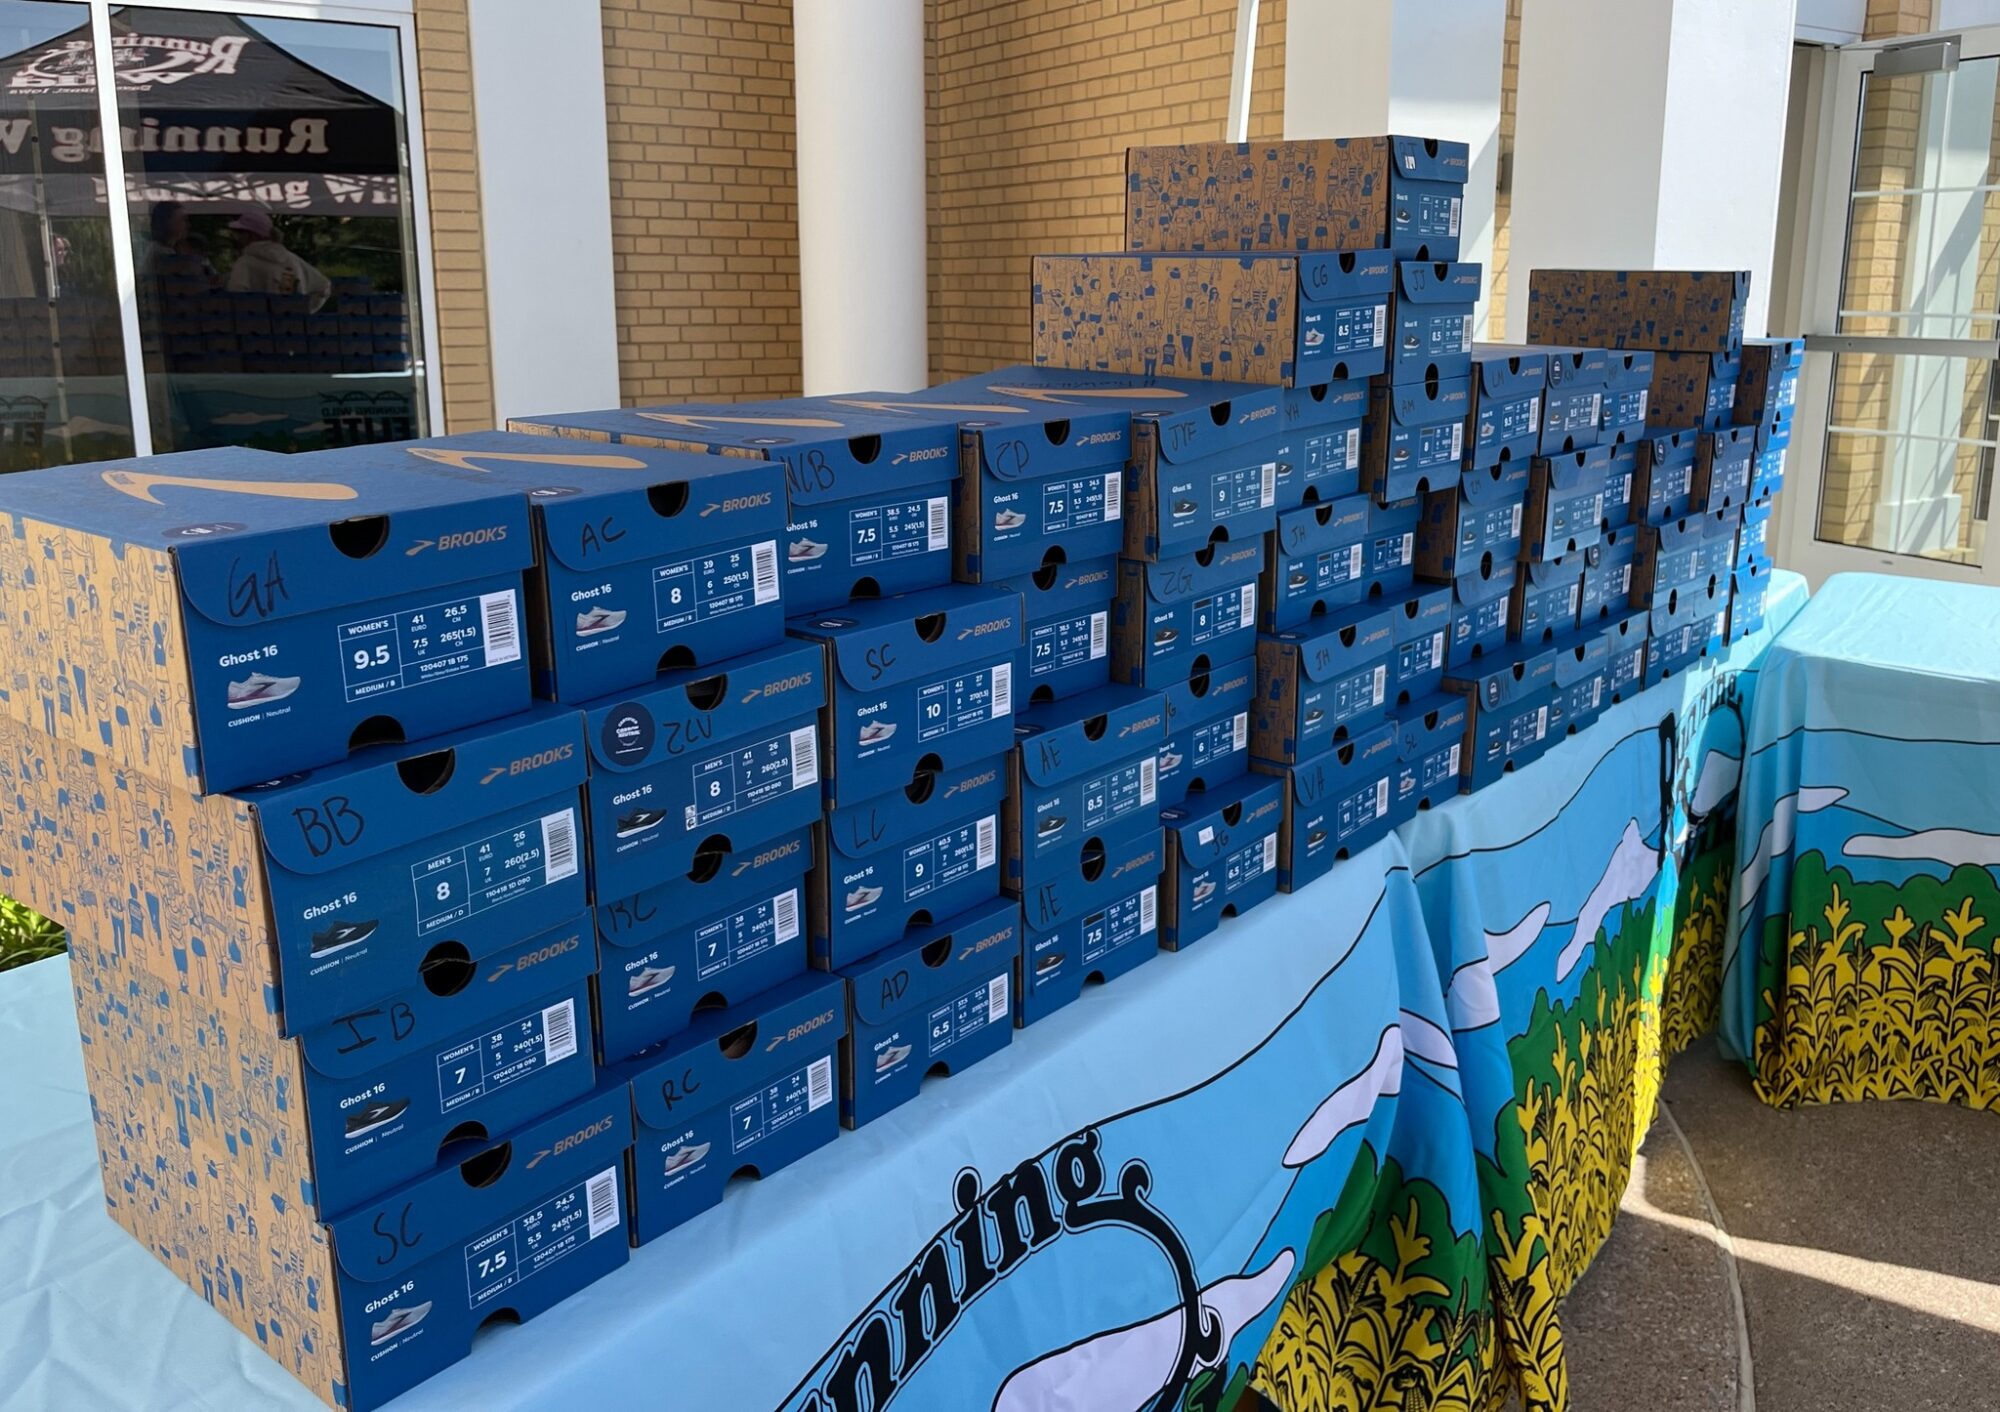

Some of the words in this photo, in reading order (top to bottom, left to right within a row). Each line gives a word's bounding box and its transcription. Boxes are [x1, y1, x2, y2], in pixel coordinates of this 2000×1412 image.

[1339, 325, 1349, 336] 8.5
[1090, 431, 1122, 443] BROOKS
[909, 447, 948, 462] BROOKS
[722, 492, 772, 512] BROOKS
[1219, 490, 1225, 501] 9
[1049, 500, 1063, 514] 7.5
[786, 522, 808, 532] Ghost
[810, 520, 817, 528] 16
[858, 528, 876, 543] 7.5
[438, 526, 507, 551] BROOKS
[581, 517, 626, 557] AC
[660, 564, 688, 577] WOMEN'S
[703, 560, 714, 569] 39
[730, 554, 740, 562] 25
[571, 587, 599, 602] Ghost
[601, 584, 612, 594] 16
[707, 580, 713, 589] 6
[671, 588, 681, 604] 8
[412, 614, 424, 625] 41
[444, 605, 467, 618] 26.5
[1200, 615, 1206, 626] 8
[348, 619, 390, 635] WOMEN'S
[974, 617, 1012, 636] BROOKS
[412, 638, 428, 649] 7.5
[440, 626, 476, 643] 265(1.5)
[219, 649, 260, 668] Ghost
[262, 645, 279, 659] 16
[353, 645, 391, 670] 9.5
[1036, 643, 1050, 657] 7.5
[866, 644, 896, 681] SC
[354, 682, 384, 696] MEDIUM
[764, 672, 812, 697] BROOKS
[228, 714, 261, 728] CUSHION
[266, 706, 291, 718] Neutral
[857, 705, 878, 717] Ghost
[879, 701, 887, 710] 16
[926, 704, 941, 718] 10
[509, 744, 574, 776] BROOKS
[743, 752, 752, 760] 41
[769, 742, 778, 751] 26
[704, 759, 723, 771] MEN'S
[746, 770, 751, 779] 7
[613, 789, 640, 806] Ghost
[643, 784, 652, 794] 16
[710, 780, 721, 797] 8
[1088, 796, 1103, 811] 8.5
[292, 796, 364, 857] BB
[479, 843, 491, 854] 41
[513, 831, 526, 842] 26
[427, 856, 452, 871] MEN'S
[484, 866, 490, 877] 7
[504, 848, 540, 869] 260(2.5)
[753, 840, 800, 868] BROOKS
[915, 864, 924, 877] 9
[436, 882, 450, 901] 8
[303, 898, 340, 921] Ghost
[343, 892, 357, 906] 16
[976, 927, 1013, 952] BROOKS
[1088, 928, 1101, 945] 7.5
[516, 935, 580, 971] BROOKS
[708, 942, 717, 957] 7
[310, 959, 340, 976] CUSHION
[625, 956, 648, 972] Ghost
[649, 952, 658, 962] 16
[882, 970, 909, 1009] AD
[491, 1034, 503, 1044] 38
[521, 1020, 532, 1031] 24
[787, 1010, 834, 1042] BROOKS
[933, 1021, 949, 1038] 6.5
[442, 1044, 475, 1062] WOMEN'S
[495, 1052, 501, 1062] 5
[455, 1067, 467, 1084] 7
[340, 1088, 371, 1109] Ghost
[372, 1083, 386, 1098] 16
[662, 1069, 700, 1111] RC
[743, 1116, 751, 1130] 7
[553, 1115, 613, 1156] BROOKS
[661, 1135, 684, 1152] Ghost
[685, 1130, 694, 1140] 16
[345, 1137, 374, 1155] CUSHION
[523, 1211, 543, 1227] 38.5
[555, 1192, 575, 1209] 24.5
[373, 1202, 423, 1265] SC
[527, 1232, 542, 1246] 5.5
[551, 1209, 582, 1232] 245(1.5)
[473, 1228, 509, 1251] WOMEN'S
[478, 1250, 508, 1280] 7.5
[775, 1127, 1150, 1411] nning
[365, 1289, 400, 1314] Ghost
[401, 1281, 414, 1295] 16
